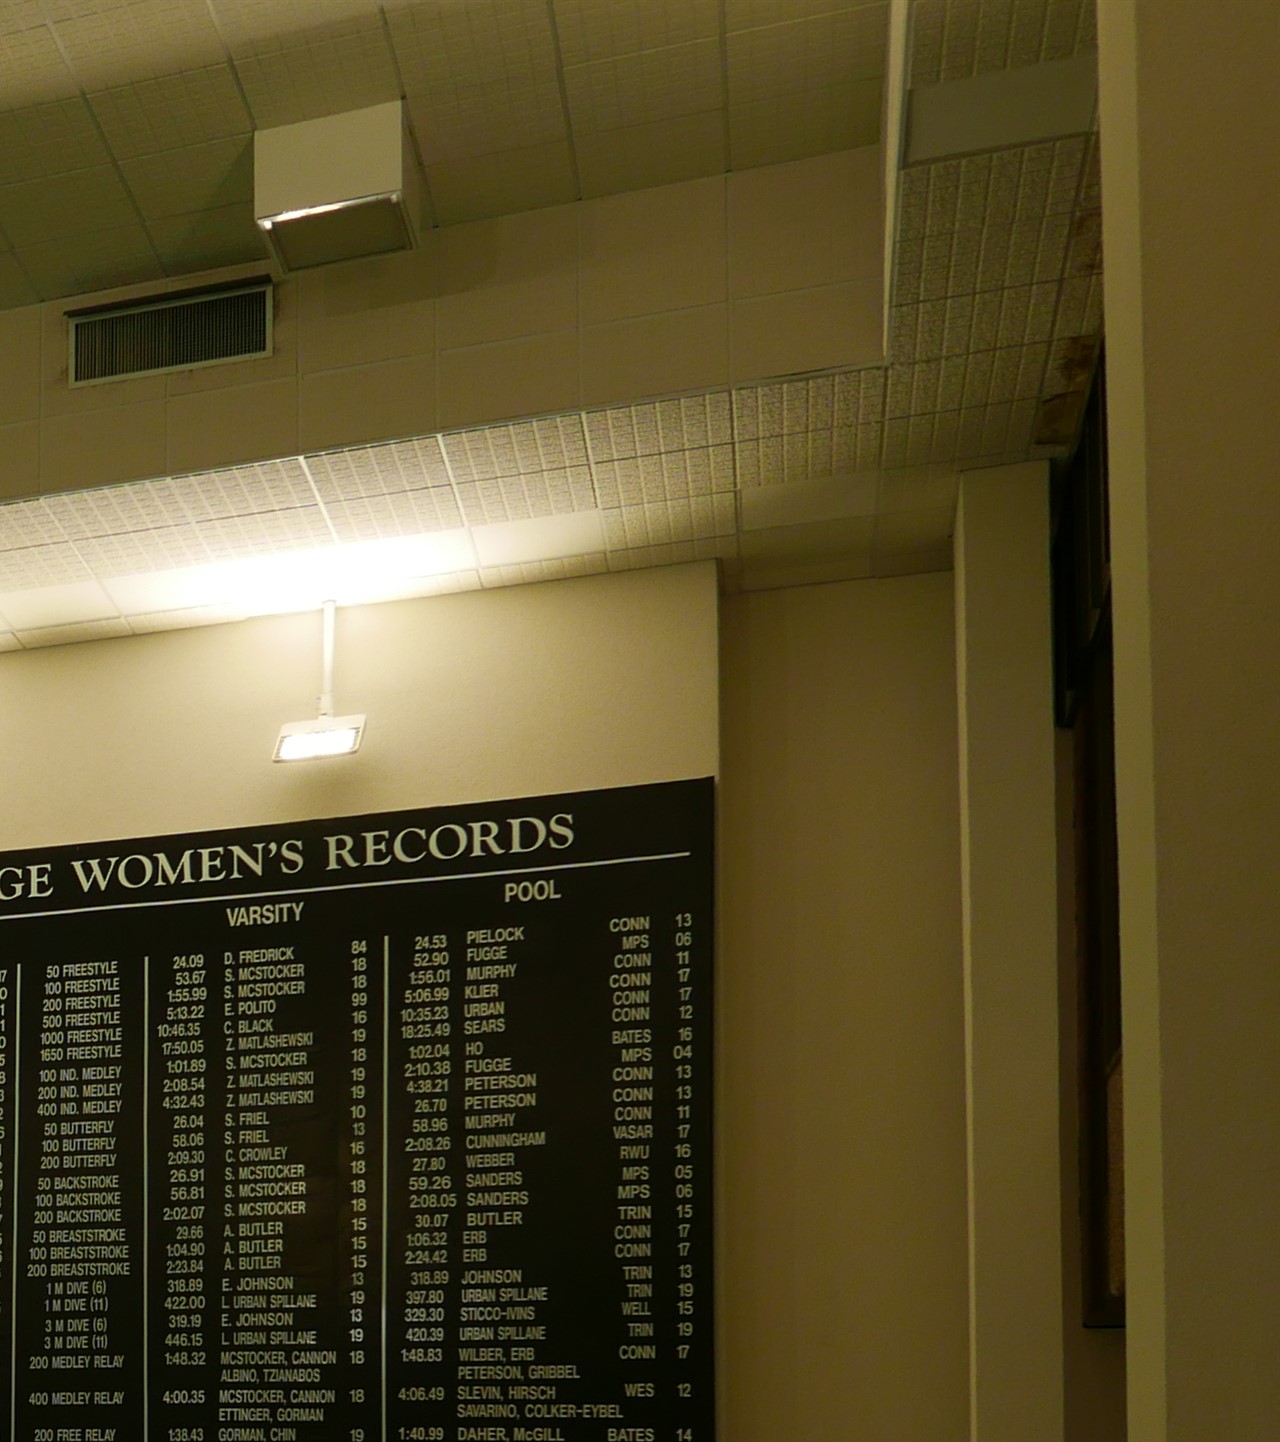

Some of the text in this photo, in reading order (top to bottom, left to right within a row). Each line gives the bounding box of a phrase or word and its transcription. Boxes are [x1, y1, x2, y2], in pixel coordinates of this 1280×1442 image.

[70, 839, 304, 893] WOMEN'S
[323, 813, 574, 871] RECORDS
[504, 879, 562, 903] POOL
[225, 901, 304, 927] VARSITY
[414, 912, 692, 951] 24.53 PIELOCK CONN 13
[413, 931, 692, 968] 52.90 FUGGE MPS 06
[175, 957, 367, 986] 53.67 S. MCSTOCKER 18
[42, 994, 121, 1012] 200 FREESTYLE
[42, 1010, 121, 1029] 500 FREESTYLE
[156, 1009, 368, 1038] 10:46.35 C. BLACK 16
[40, 1027, 123, 1046] 1000 FREESTYLE
[40, 1044, 122, 1062] 1650 FREESTYLE
[39, 1065, 122, 1083] 100 IND. MEDLEY
[40, 1153, 118, 1170] 200 BUTTERFLY
[408, 1164, 694, 1191] 59.26 SANDERS MPS 05
[35, 1191, 122, 1208] 100 BACKSTROKE
[170, 1179, 367, 1201] 56.81 S. MCSTOCKER 18
[414, 1204, 693, 1229] 30.07 BUTLER TRIN 15
[27, 1262, 131, 1278] 200 BREASTSTROKE
[46, 1279, 107, 1296] 1 M DIVE (6)
[167, 1271, 364, 1294] 318.89 E. JOHNSON 13
[29, 1355, 125, 1370] 200 MEDLEY RELAY
[162, 1388, 366, 1405] 4:00.35 MCSTOCKER, CANNON 18
[398, 1426, 693, 1442] 1:40.99 DAHER, McGILL BATES 14
